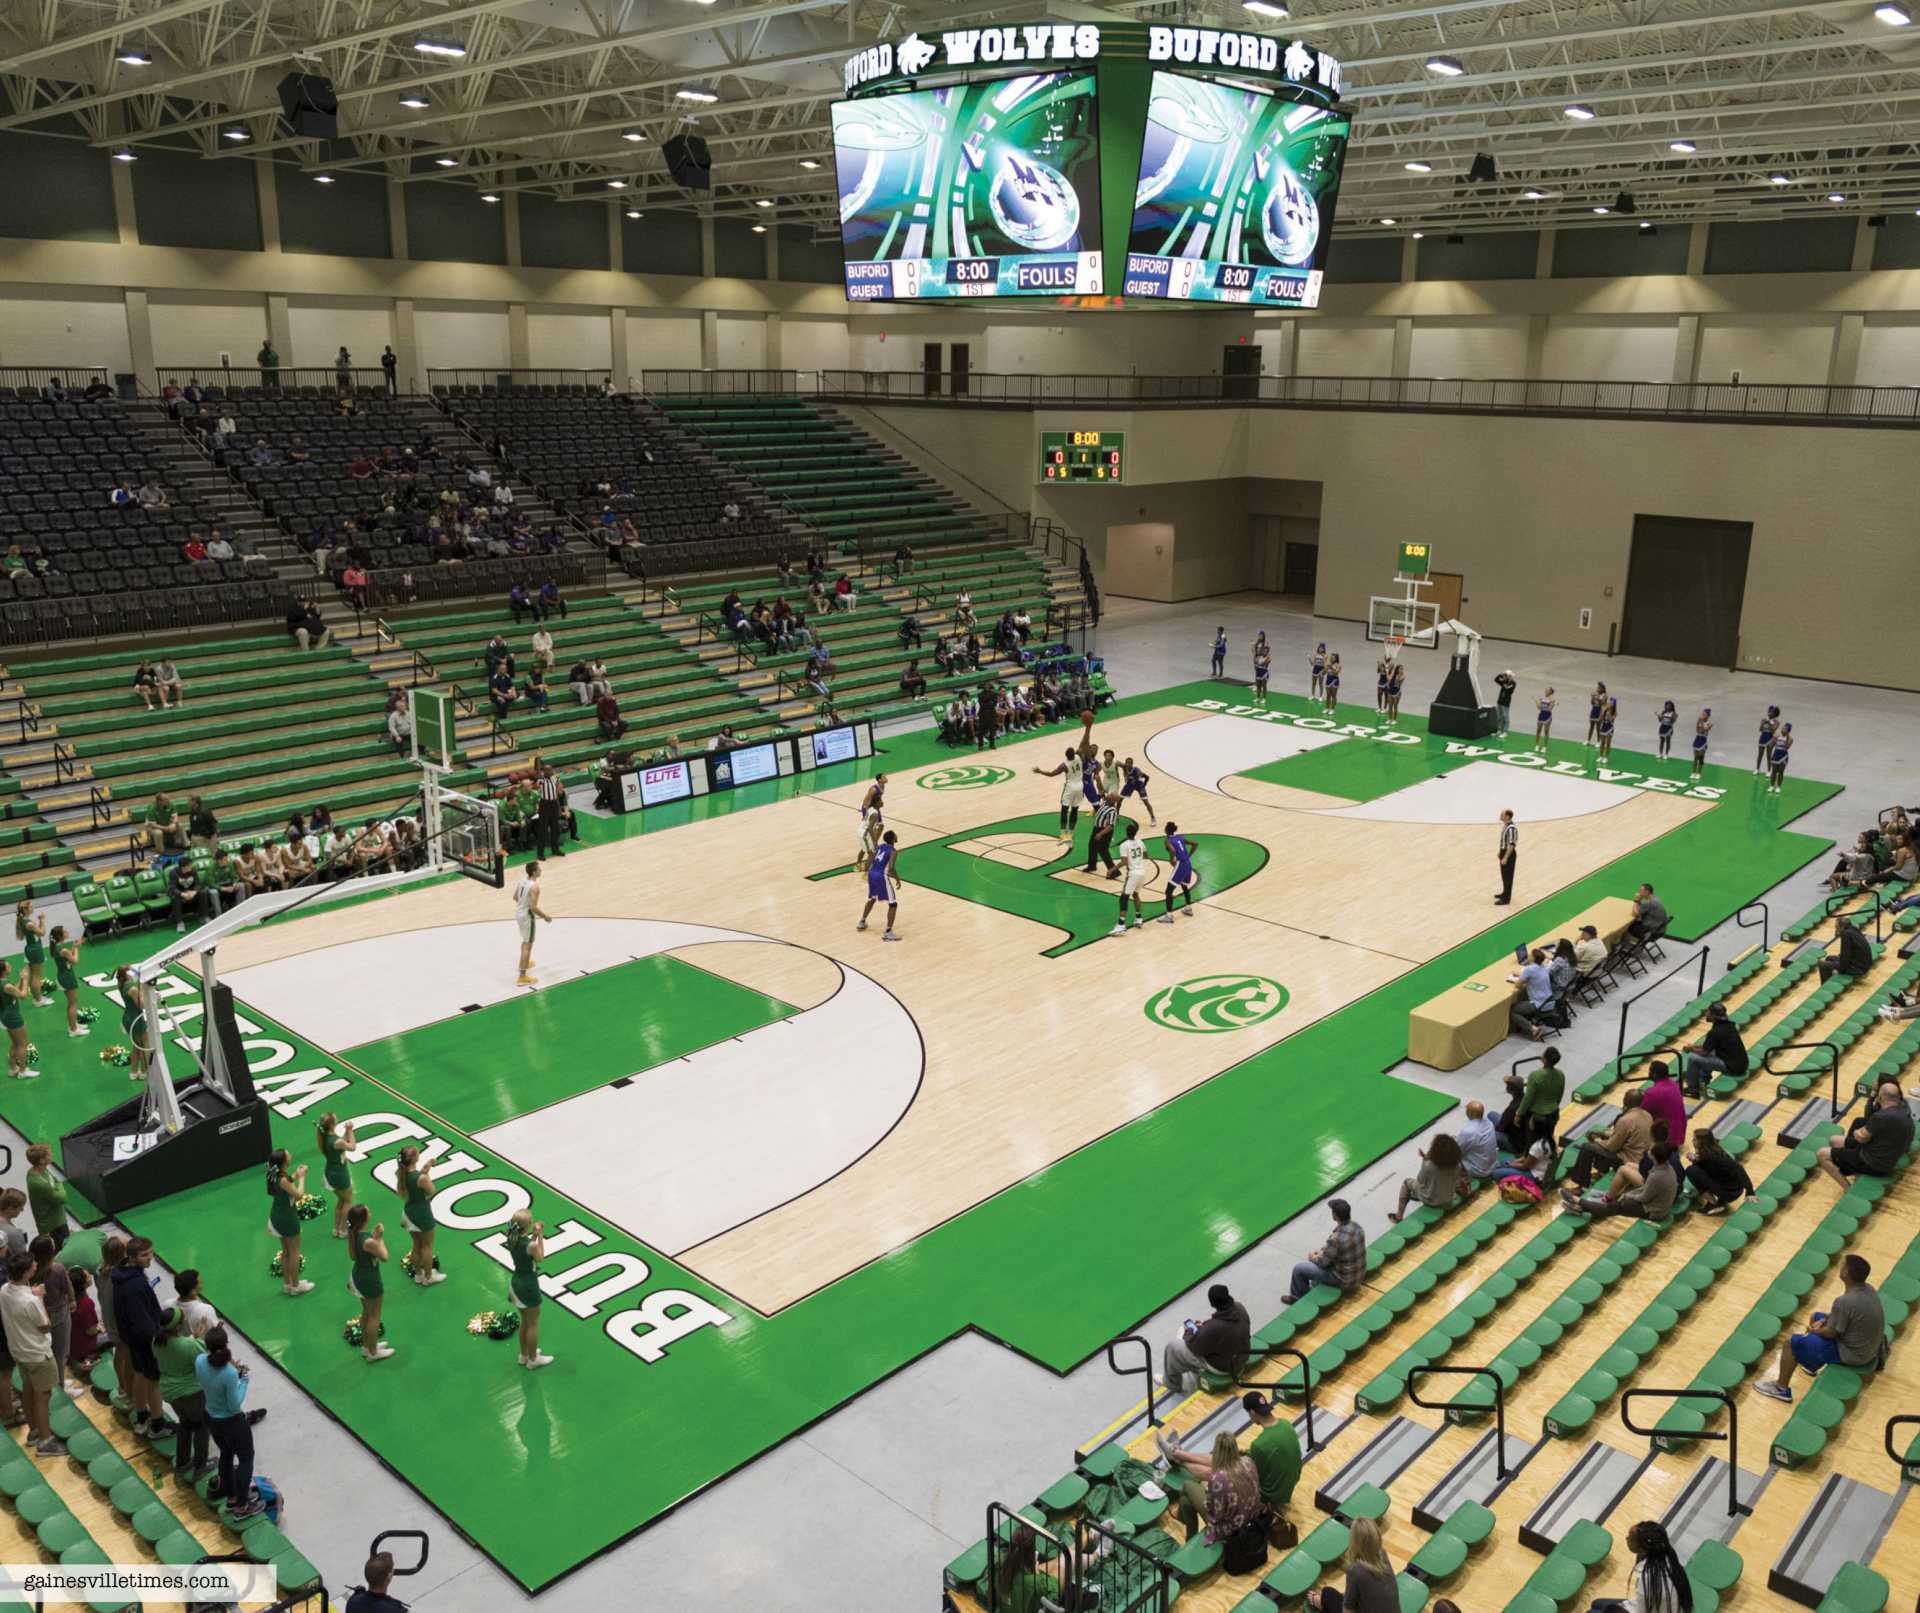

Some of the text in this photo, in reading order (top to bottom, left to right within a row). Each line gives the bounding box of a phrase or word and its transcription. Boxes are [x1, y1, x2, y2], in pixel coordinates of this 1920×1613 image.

[943, 25, 1100, 64] WOLVES
[1149, 27, 1278, 71] BUFORD
[847, 265, 889, 278] BUFORD
[907, 262, 915, 277] 0
[956, 262, 989, 280] 8:00
[1129, 258, 1169, 275] BUFORD
[1184, 262, 1192, 277] 0
[1019, 267, 1075, 286] FOULS
[1223, 268, 1250, 287] 8:00
[850, 285, 884, 297] GUEST
[908, 281, 917, 296] 0
[1127, 280, 1160, 295] GUEST
[1181, 282, 1189, 297] 0
[1267, 280, 1304, 298] FOULS
[1074, 432, 1099, 445] 8:00
[1055, 451, 1064, 464] 0
[1111, 451, 1120, 465] 0
[1047, 466, 1055, 478] 0
[1111, 466, 1119, 478] 0
[1186, 699, 1728, 800] BUFORD WOLVES
[645, 768, 681, 785] ELITE
